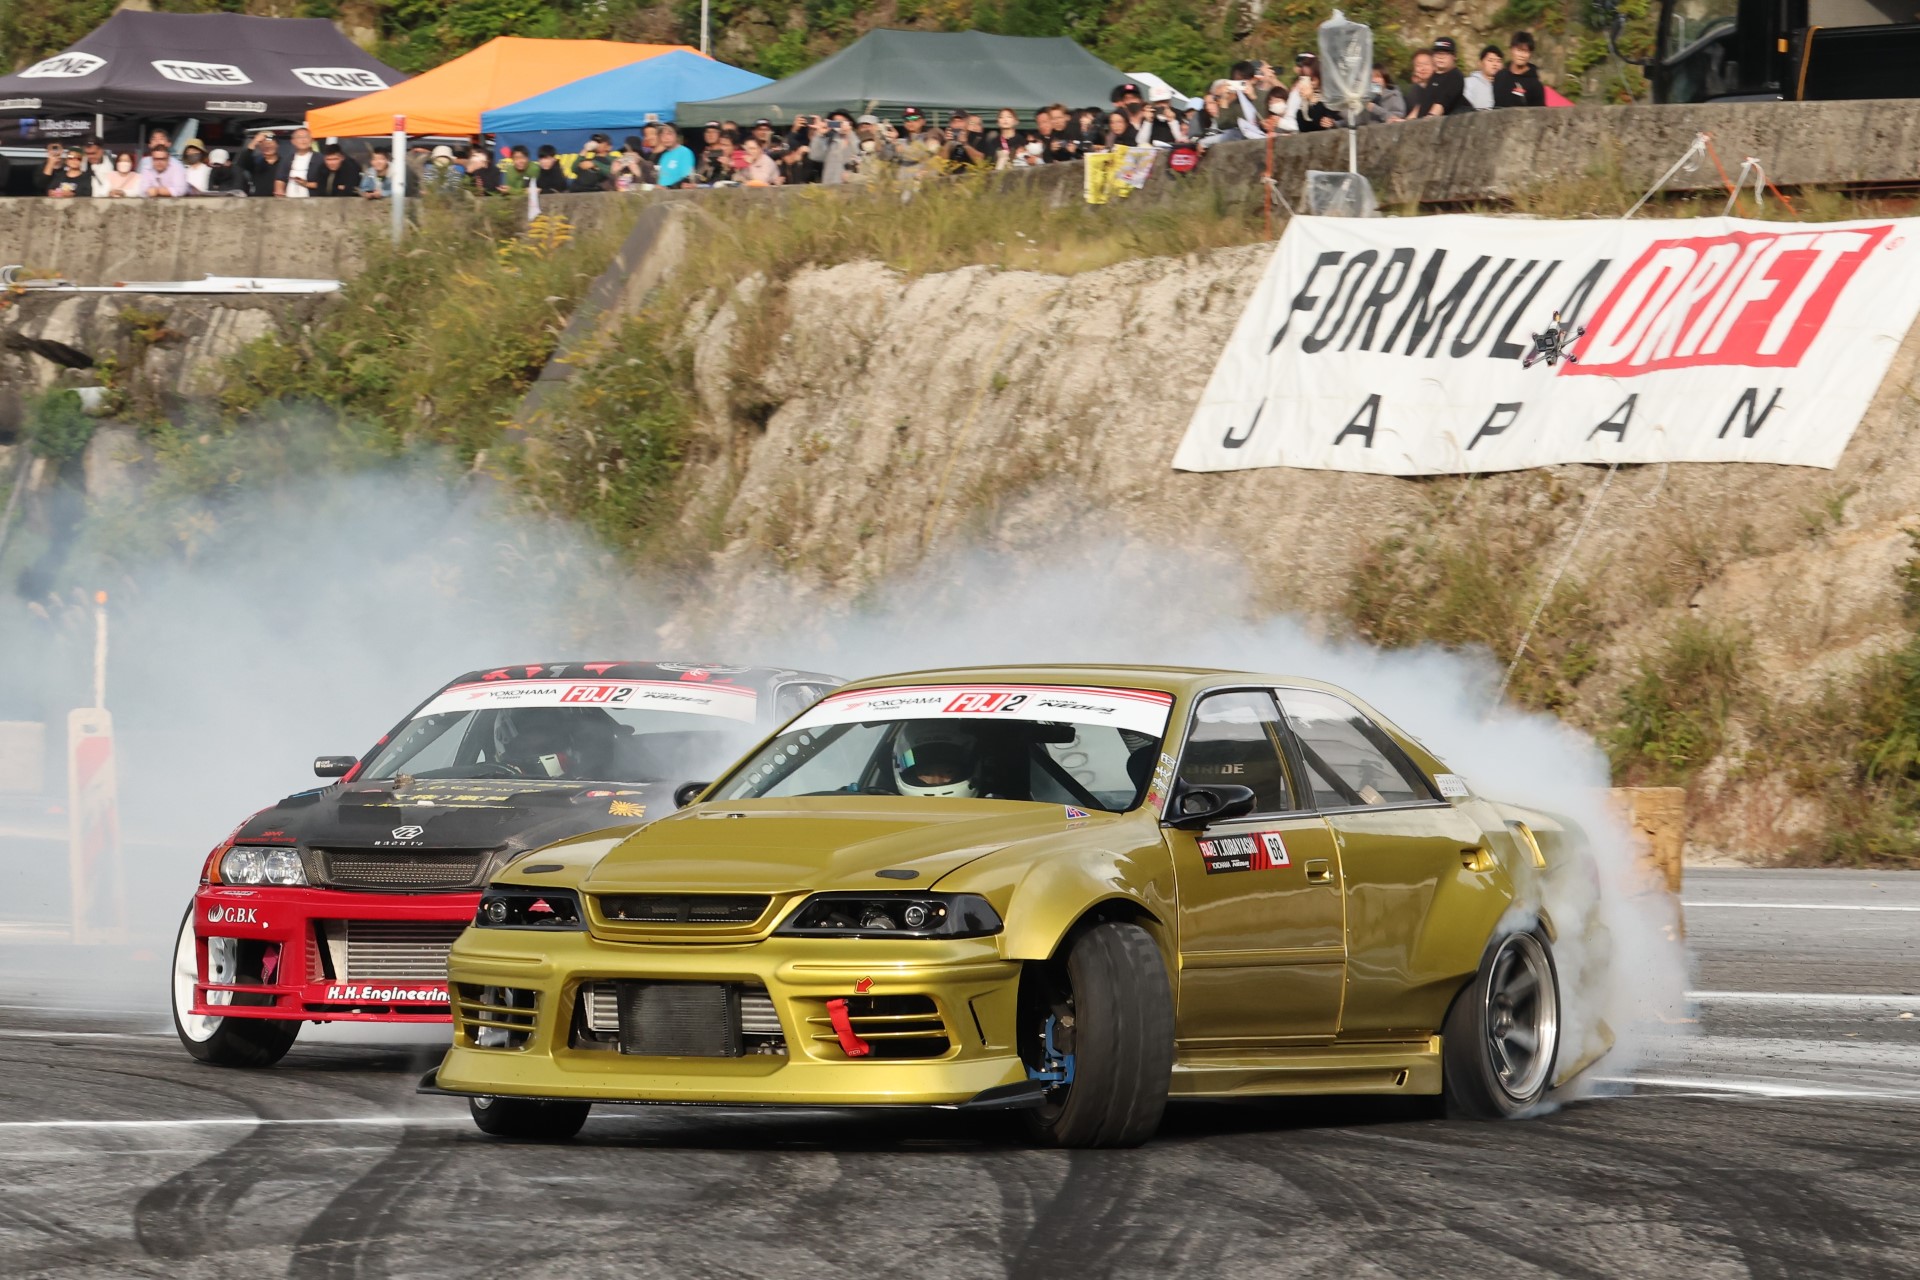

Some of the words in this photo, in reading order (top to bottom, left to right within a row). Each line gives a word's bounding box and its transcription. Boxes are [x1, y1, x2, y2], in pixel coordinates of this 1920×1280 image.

[162, 64, 240, 82] TONE
[301, 71, 378, 87] TONE
[1267, 247, 1614, 360] FORMULA
[1575, 230, 1874, 367] DRIFT
[1222, 386, 1783, 450] JAPAN
[489, 688, 557, 697] YOKOHAMA
[867, 697, 942, 707] YOKOHAMA
[1185, 763, 1245, 774] BRIDE
[1267, 837, 1284, 861] 68
[224, 907, 258, 923] G.B.K
